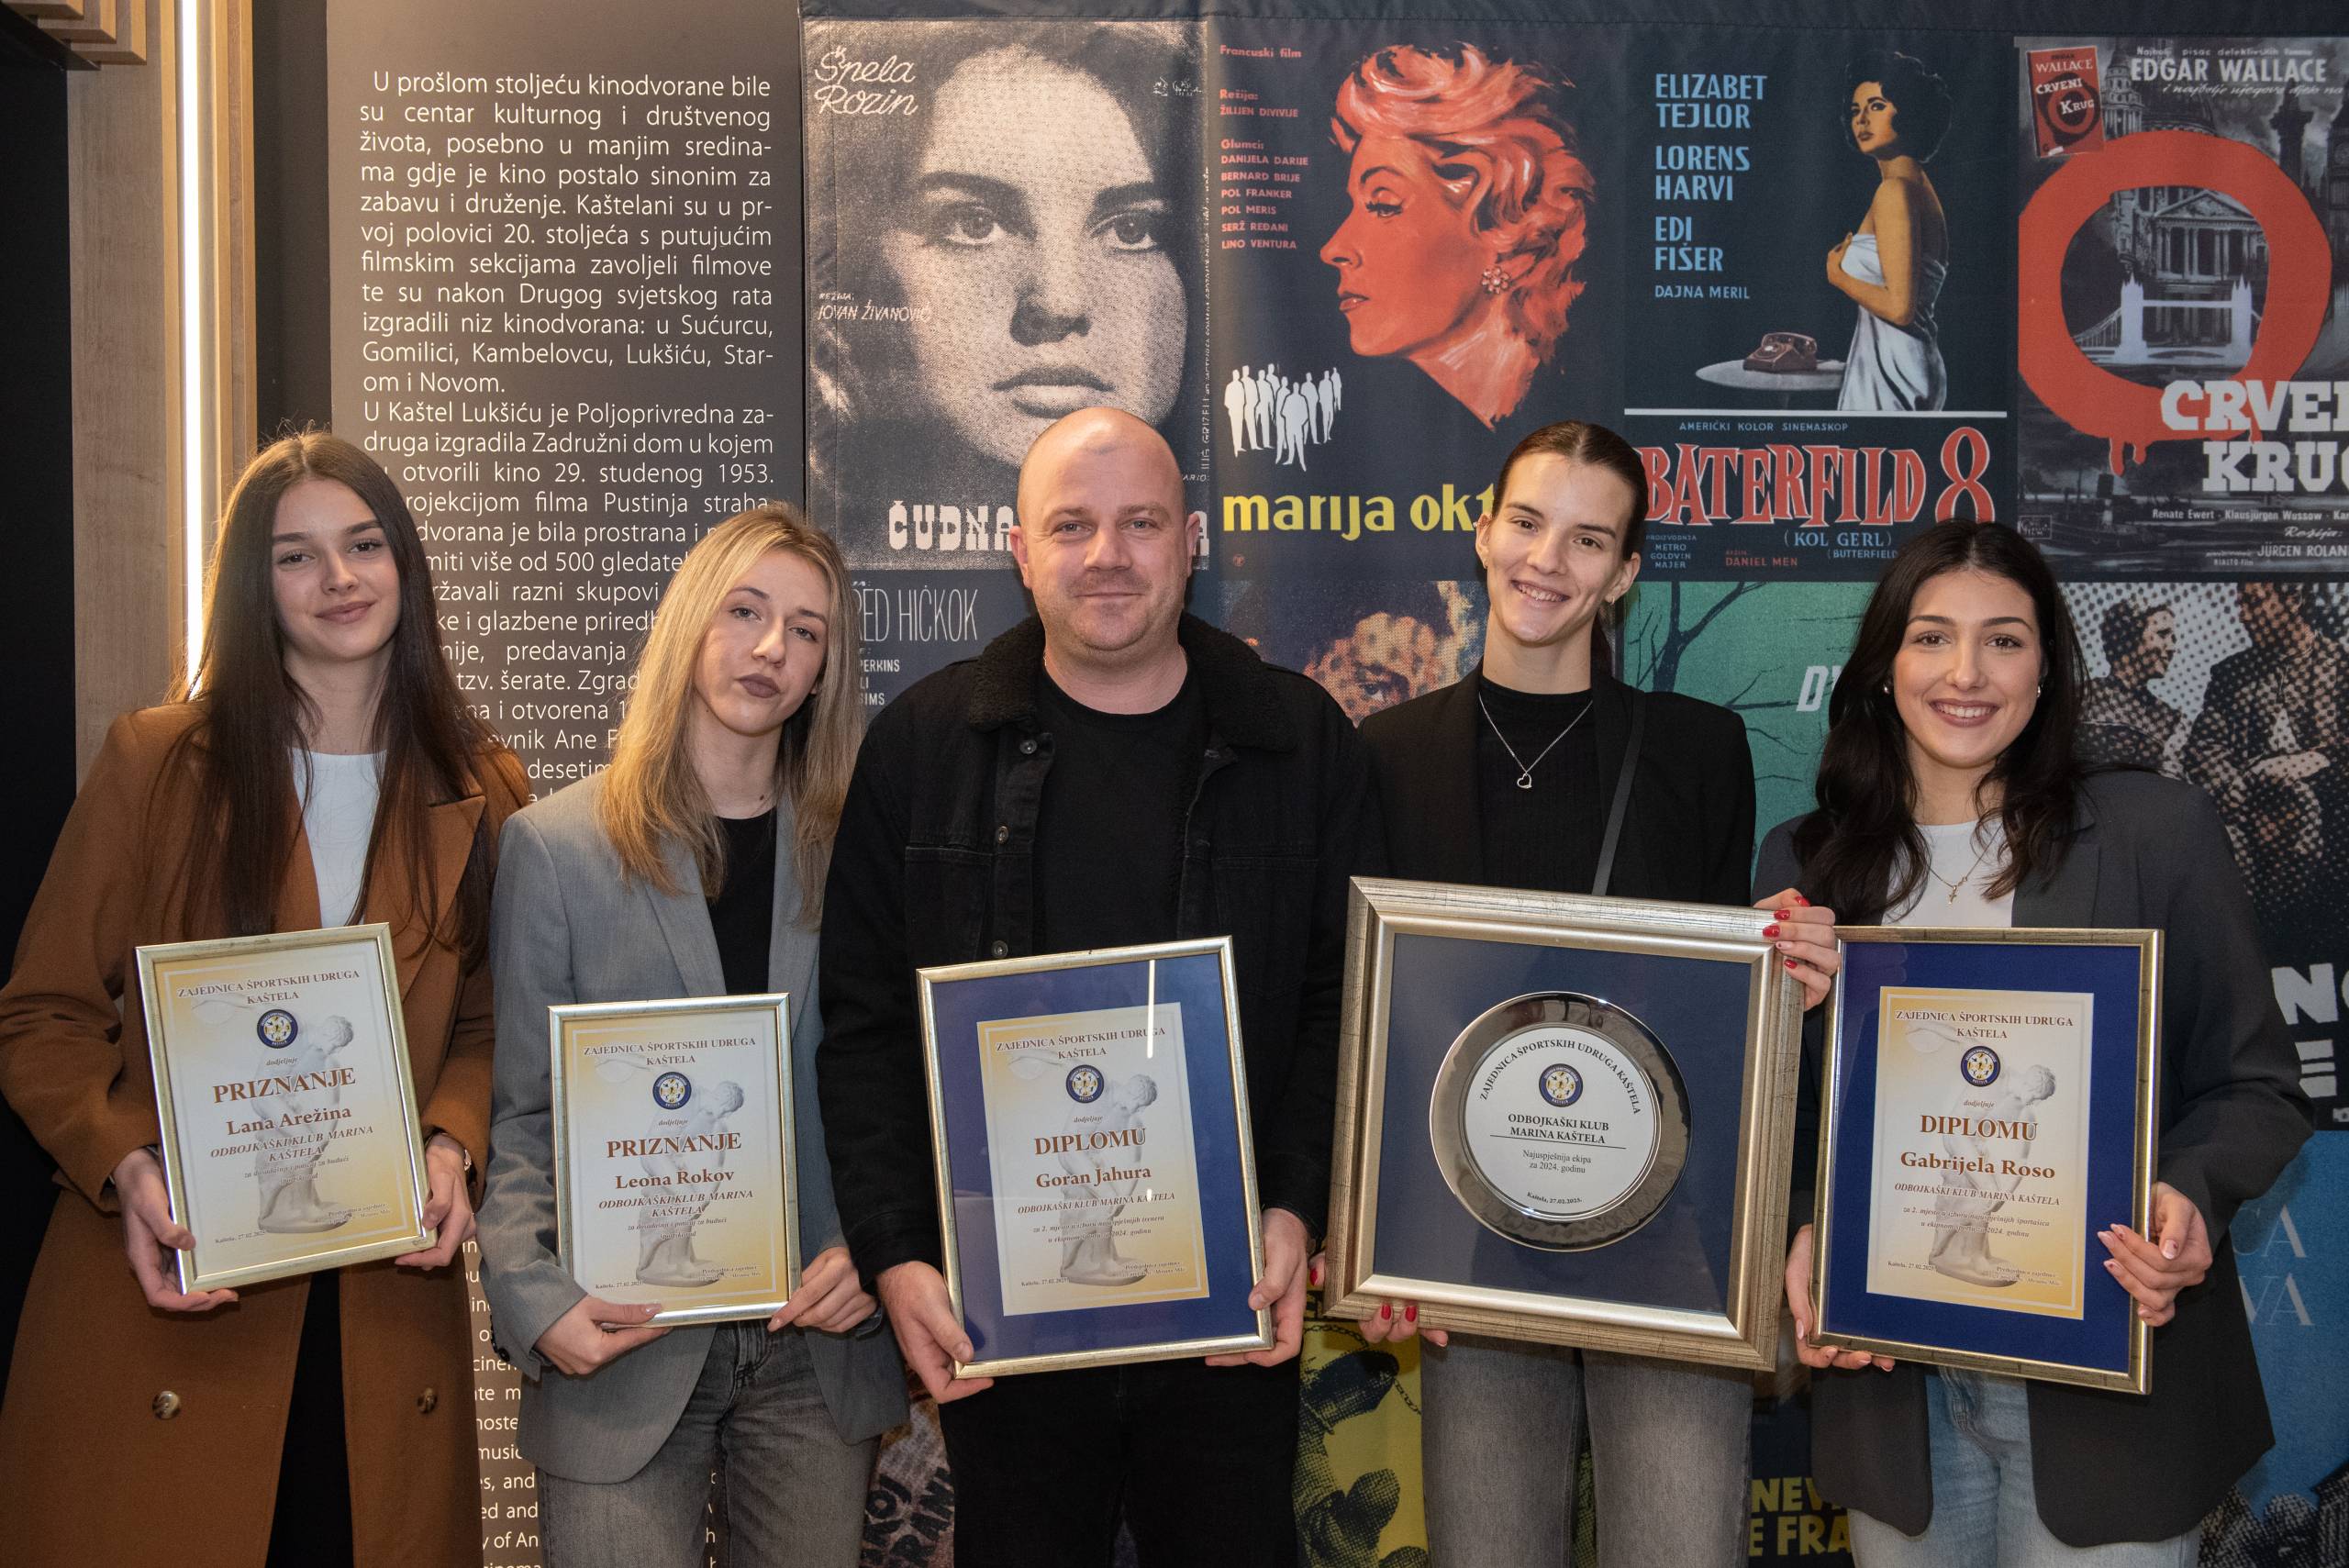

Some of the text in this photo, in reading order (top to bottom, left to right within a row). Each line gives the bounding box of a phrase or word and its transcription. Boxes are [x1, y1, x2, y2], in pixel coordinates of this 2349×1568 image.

[1220, 45, 1301, 58] Francuski film
[2036, 59, 2093, 72] WALLACE
[2131, 58, 2327, 82] EDGAR WALLACE
[373, 70, 771, 100] U prošlom stoljeću kinodvorane bile
[1220, 89, 1258, 101] Režija:
[1655, 73, 1767, 100] ELIZABET
[2035, 78, 2083, 95] CRVENI
[815, 84, 918, 117] Rozin
[360, 102, 771, 132] su centar kulturnog i društvenog
[1656, 104, 1752, 128] TEJLOR
[359, 129, 772, 161] života, posebno u manjim sredina-
[1221, 139, 1264, 150] Glumci:
[1221, 155, 1269, 164] DANIJELA
[1655, 146, 1751, 171] LORENS
[361, 161, 771, 190] ma gdje je kino postalo sinonim za
[1221, 172, 1300, 183] BERNARD BRIJE
[1221, 189, 1292, 198] POL FRANKER
[1655, 175, 1733, 201] HARVI
[360, 190, 773, 221] zabavu i druženje. Kaštelani su u pr-
[1221, 206, 1276, 215] POL MERIS
[360, 220, 772, 251] voj polovici 20. stoljeća s putujućim
[1221, 221, 1245, 232] SERŽ
[1655, 217, 1692, 242] EDI
[1222, 240, 1297, 250] LINO VENTURA
[1655, 243, 1723, 272] FIŠER
[1654, 285, 1750, 300] DAJNA MERIL
[1738, 423, 1774, 431] KOLOR
[1782, 423, 1848, 432] SINEMASKOP
[2203, 440, 2349, 492] KRU
[1639, 426, 1995, 528] BATERFILD 8
[2153, 508, 2183, 518] Renate
[2188, 509, 2214, 519] Ewert
[1725, 558, 1798, 566] DANIEL MEN
[178, 970, 360, 998] ZAJEDNICA ŠPORTSKIH UDRUGA
[247, 990, 299, 1005] KAŠTELA
[1896, 1010, 2073, 1027] ZAJEDNICA ŠPORTSKIH UDRUGA
[996, 1038, 1055, 1051] ZAJEDNICA
[1058, 1031, 1118, 1045] ŠPORTSKIH
[1956, 1027, 2008, 1039] KAŠTELA
[584, 1037, 756, 1055] ZAJEDNICA ŠPORTSKIH UDRUGA
[1058, 1047, 1107, 1060] KAŠTELA
[646, 1054, 696, 1066] KAŠTELA
[212, 1067, 356, 1103] PRIZNANJE
[1480, 1040, 1641, 1115] ZAJEDNICA ŠPORTSKIH UDRUGA KAŠTELA
[227, 1107, 351, 1136] Lana Arežina
[1508, 1113, 1609, 1130] ODBOJKAŠKI KLUB
[1920, 1115, 2038, 1141] DIPLOMU
[210, 1126, 373, 1158] ODBOJKAŠKI KLUB MARINA
[607, 1132, 742, 1158] PRIZNANJE
[1034, 1128, 1146, 1155] DIPLOMU
[1510, 1127, 1605, 1143] MARINA KAŠTELA
[269, 1146, 323, 1162] KAŠTELA
[1523, 1150, 1591, 1163] Najuspješnija ekipa
[1540, 1162, 1559, 1171] 2024.
[1561, 1165, 1586, 1173] godinu
[1900, 1151, 2055, 1179] Gabrijela Roso
[616, 1169, 735, 1189] Leona Rokov
[1036, 1167, 1152, 1188] Goran Jahura
[598, 1190, 753, 1209] ODBOJKAŠKI KLUB MARINA
[1018, 1193, 1175, 1214] ODBOJKAŠKI KLUB MARINA KATELA
[1895, 1183, 2060, 1206] ODBOJKAŠKI KLUB MARINA KAŠTELA
[651, 1205, 704, 1218] KAŠTELA
